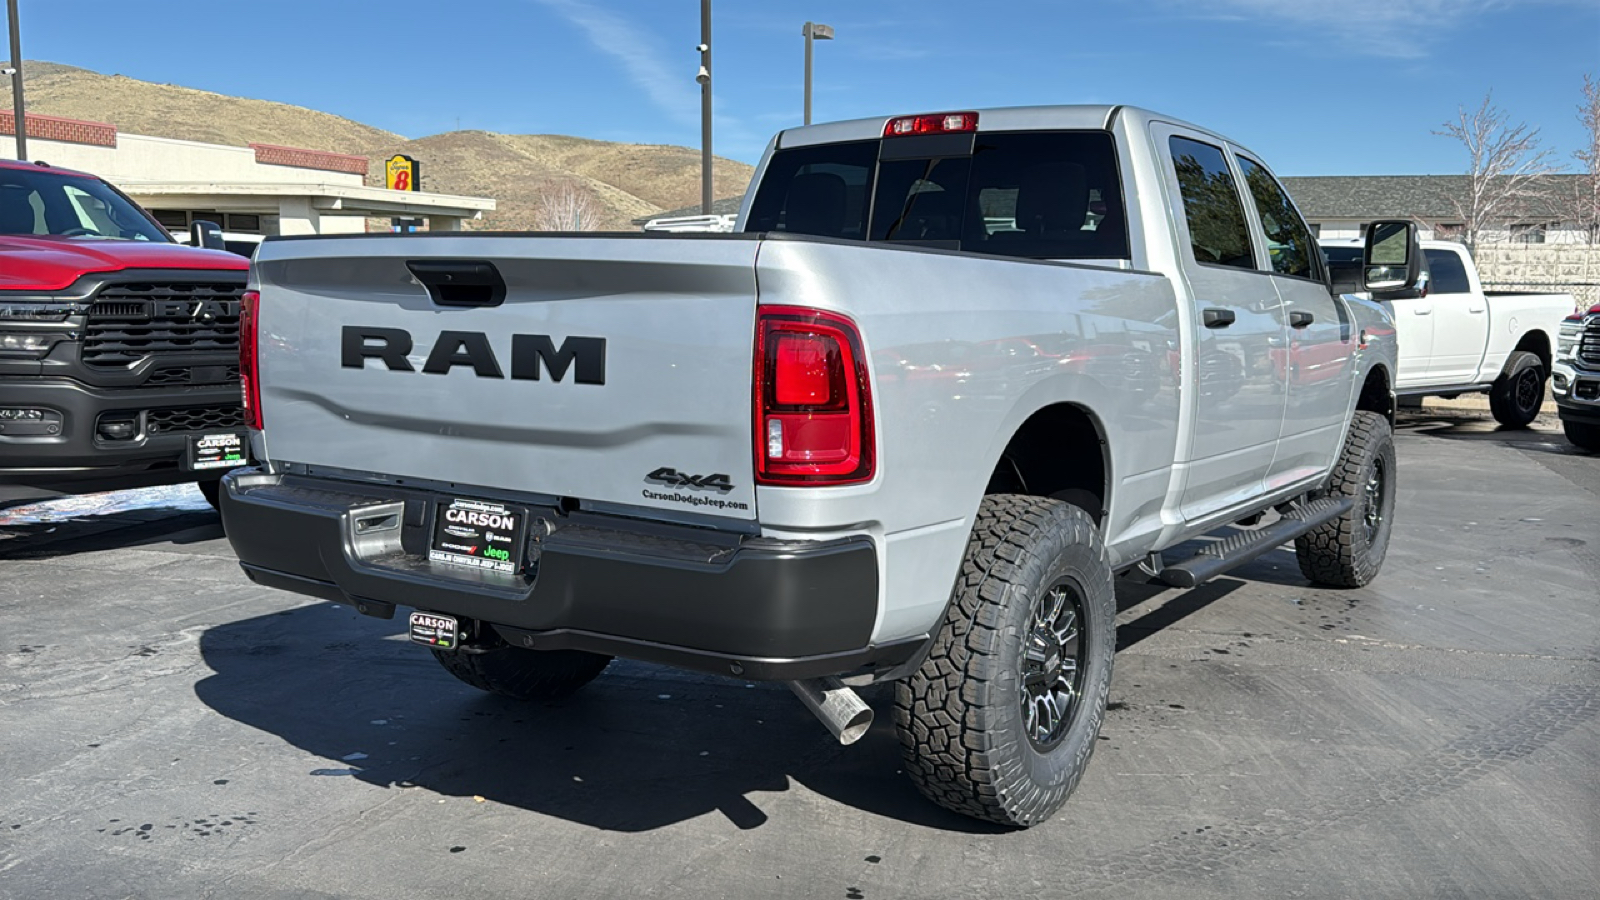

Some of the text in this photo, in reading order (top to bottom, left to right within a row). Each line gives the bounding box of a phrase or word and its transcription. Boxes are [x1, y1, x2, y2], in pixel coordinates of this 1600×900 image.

[394, 171, 409, 190] 8
[341, 325, 606, 386] RAM
[197, 438, 240, 448] CARSON
[642, 489, 748, 510] CarsonDodgeJeep.com
[445, 509, 514, 530] CARSON
[484, 545, 509, 560] Jeep
[411, 615, 454, 630] CARSON
